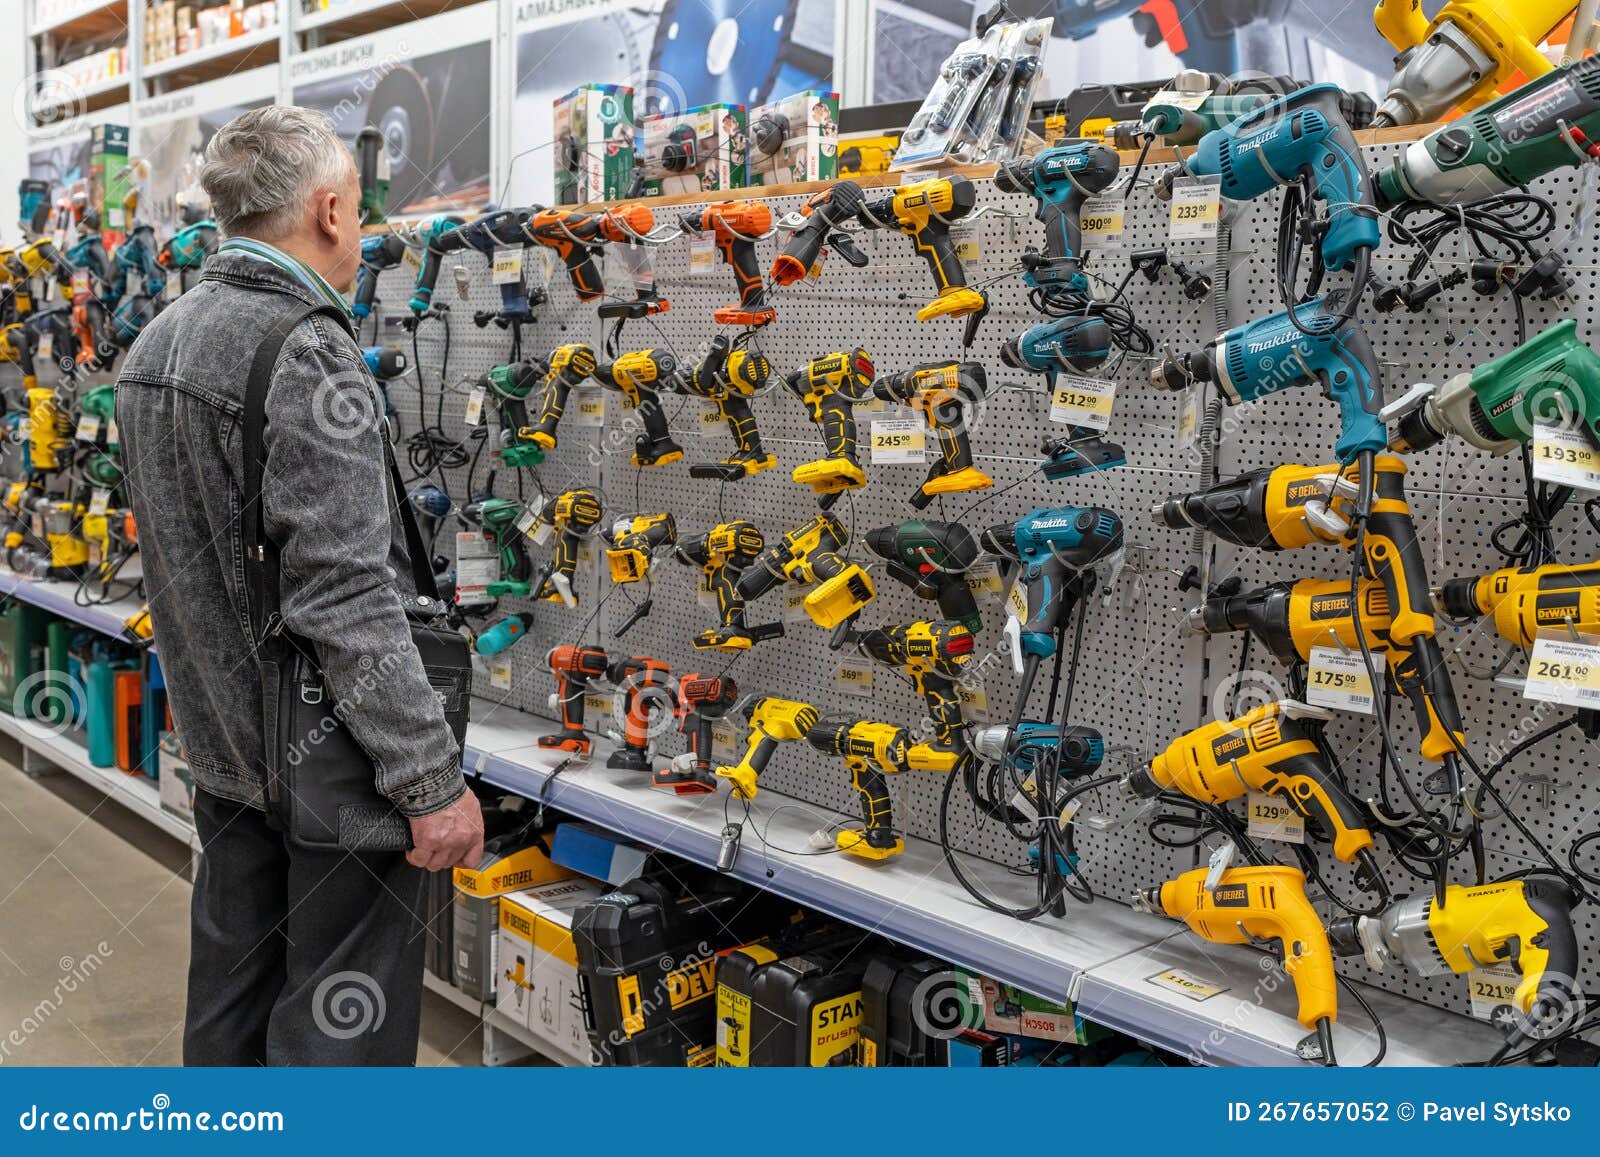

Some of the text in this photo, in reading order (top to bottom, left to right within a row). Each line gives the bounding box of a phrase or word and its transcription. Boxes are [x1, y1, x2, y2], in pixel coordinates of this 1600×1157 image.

[1177, 208, 1198, 219] 233
[1081, 219, 1103, 230] 390
[814, 362, 840, 373] STANLEY
[1058, 392, 1086, 407] 512
[704, 414, 720, 423] 496
[877, 436, 900, 447] 245
[1542, 446, 1591, 462] 193 00
[1031, 518, 1067, 530] Makita
[1321, 598, 1349, 612] DENZEL
[841, 669, 857, 680] 369
[1537, 662, 1589, 680] 261 00
[1314, 670, 1356, 687] 175 00
[1255, 805, 1289, 819] 129 00
[502, 869, 534, 888] DENZEL
[510, 912, 532, 936] DENZEL
[1475, 982, 1516, 999] 221 00
[1024, 1018, 1055, 1032] BOSCH
